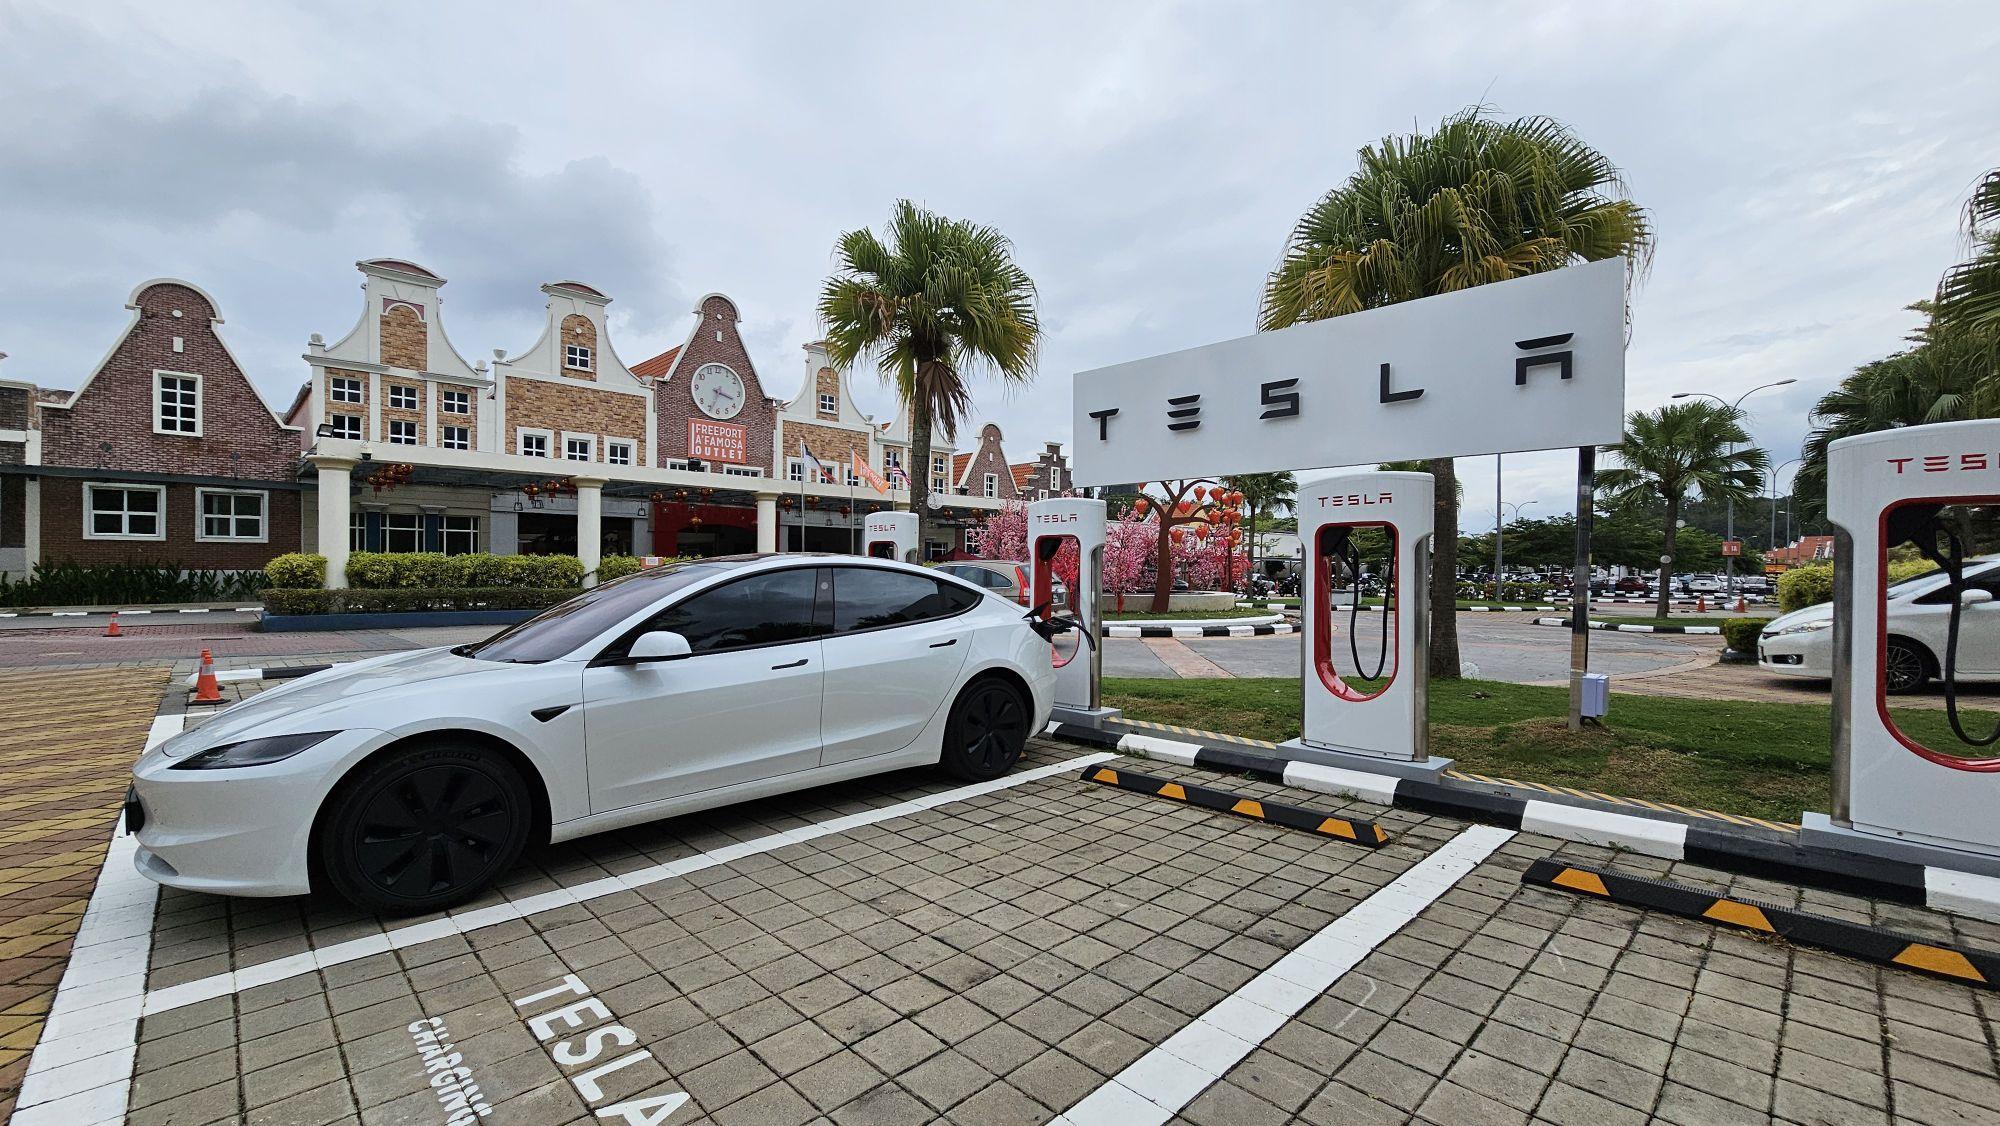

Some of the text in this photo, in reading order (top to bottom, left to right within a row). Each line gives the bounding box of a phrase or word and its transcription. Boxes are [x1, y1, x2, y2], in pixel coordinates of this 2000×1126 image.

[1088, 332, 1575, 441] TESLA
[695, 423, 743, 439] FREEPORT
[695, 434, 743, 450] A'FAMOSA
[695, 445, 743, 460] OUTLET
[1886, 453, 2000, 474] TES
[1317, 492, 1393, 508] TESLA
[1036, 513, 1077, 523] TESLA
[868, 524, 896, 532] TESLA
[514, 973, 691, 1126] TESLA
[408, 1016, 493, 1126] CHARGING
